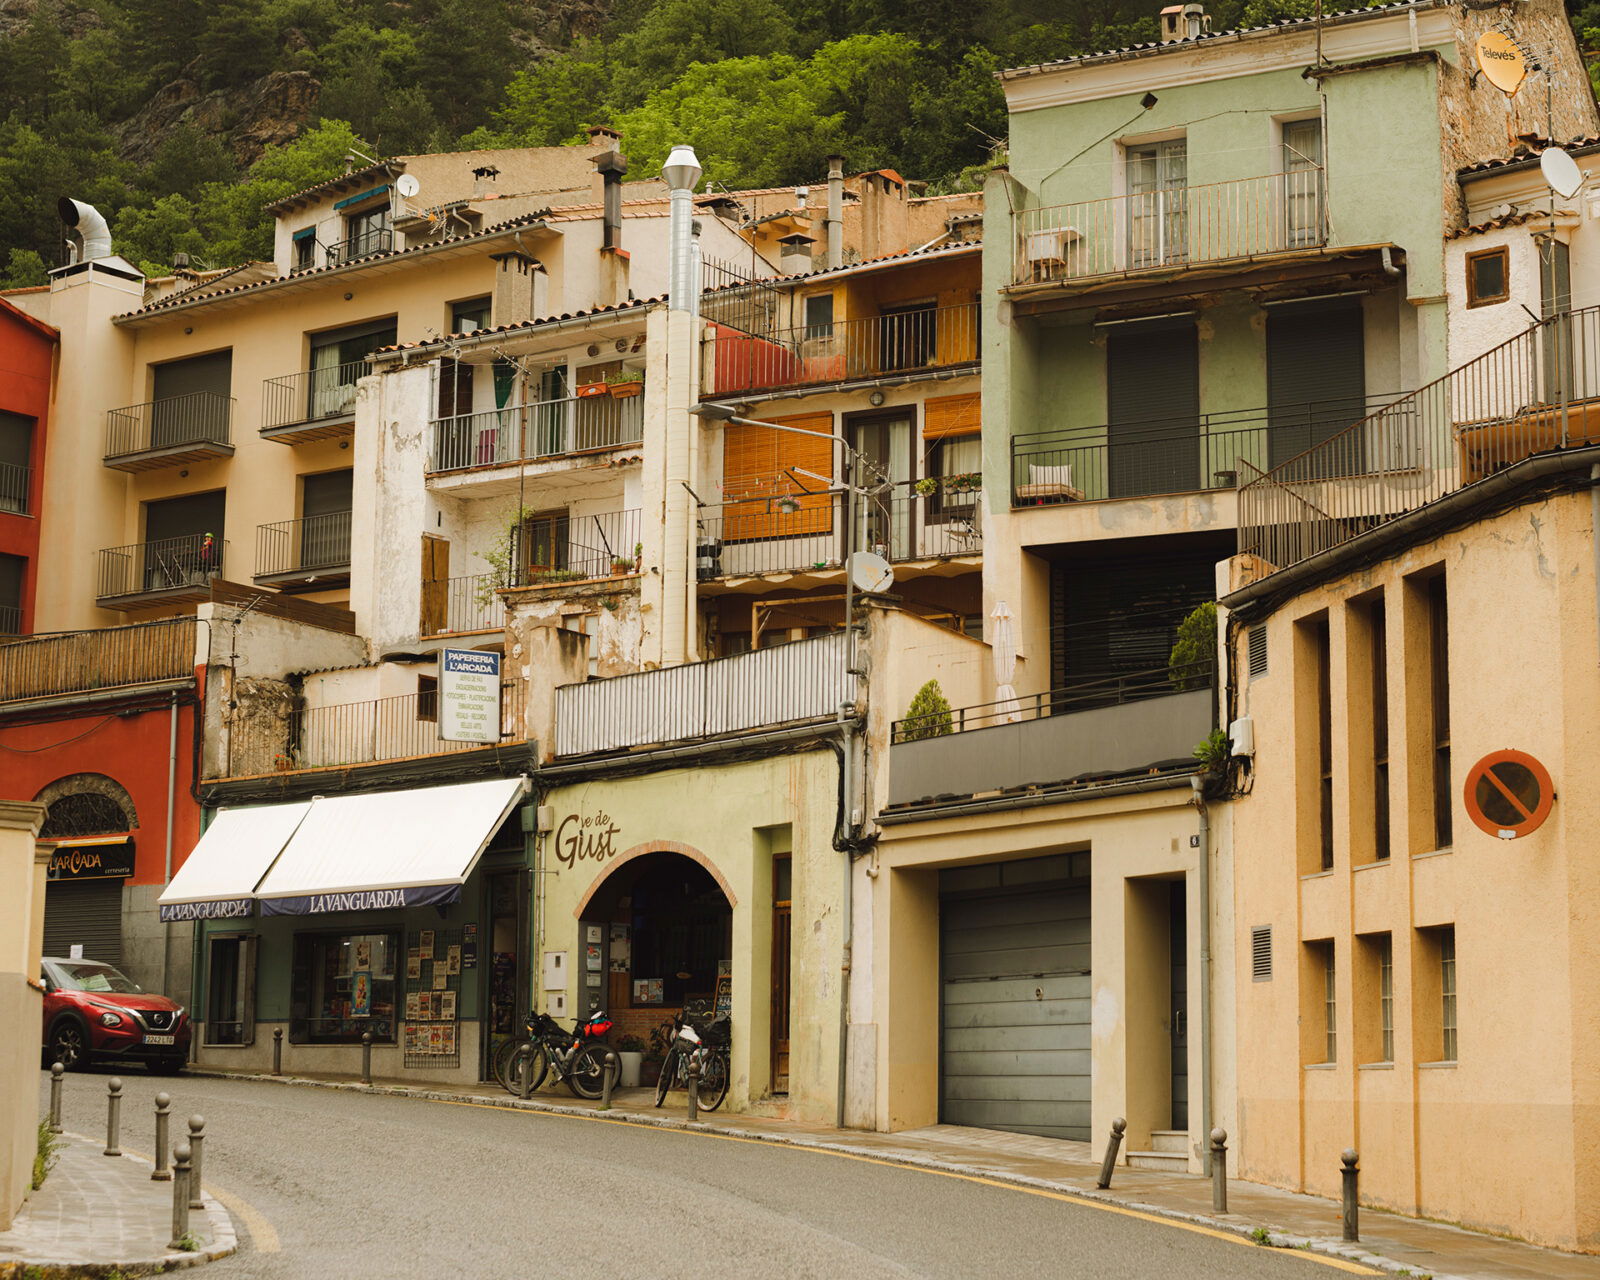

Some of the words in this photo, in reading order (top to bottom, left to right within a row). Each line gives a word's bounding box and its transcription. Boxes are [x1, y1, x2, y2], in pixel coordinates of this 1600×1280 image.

[1481, 46, 1516, 60] Televés
[449, 653, 494, 664] PAPERERIA
[449, 663, 493, 674] L'ARCADA
[595, 810, 611, 825] de
[325, 888, 406, 912] VANGUARDIA
[175, 900, 248, 919] VANGUARDIA
